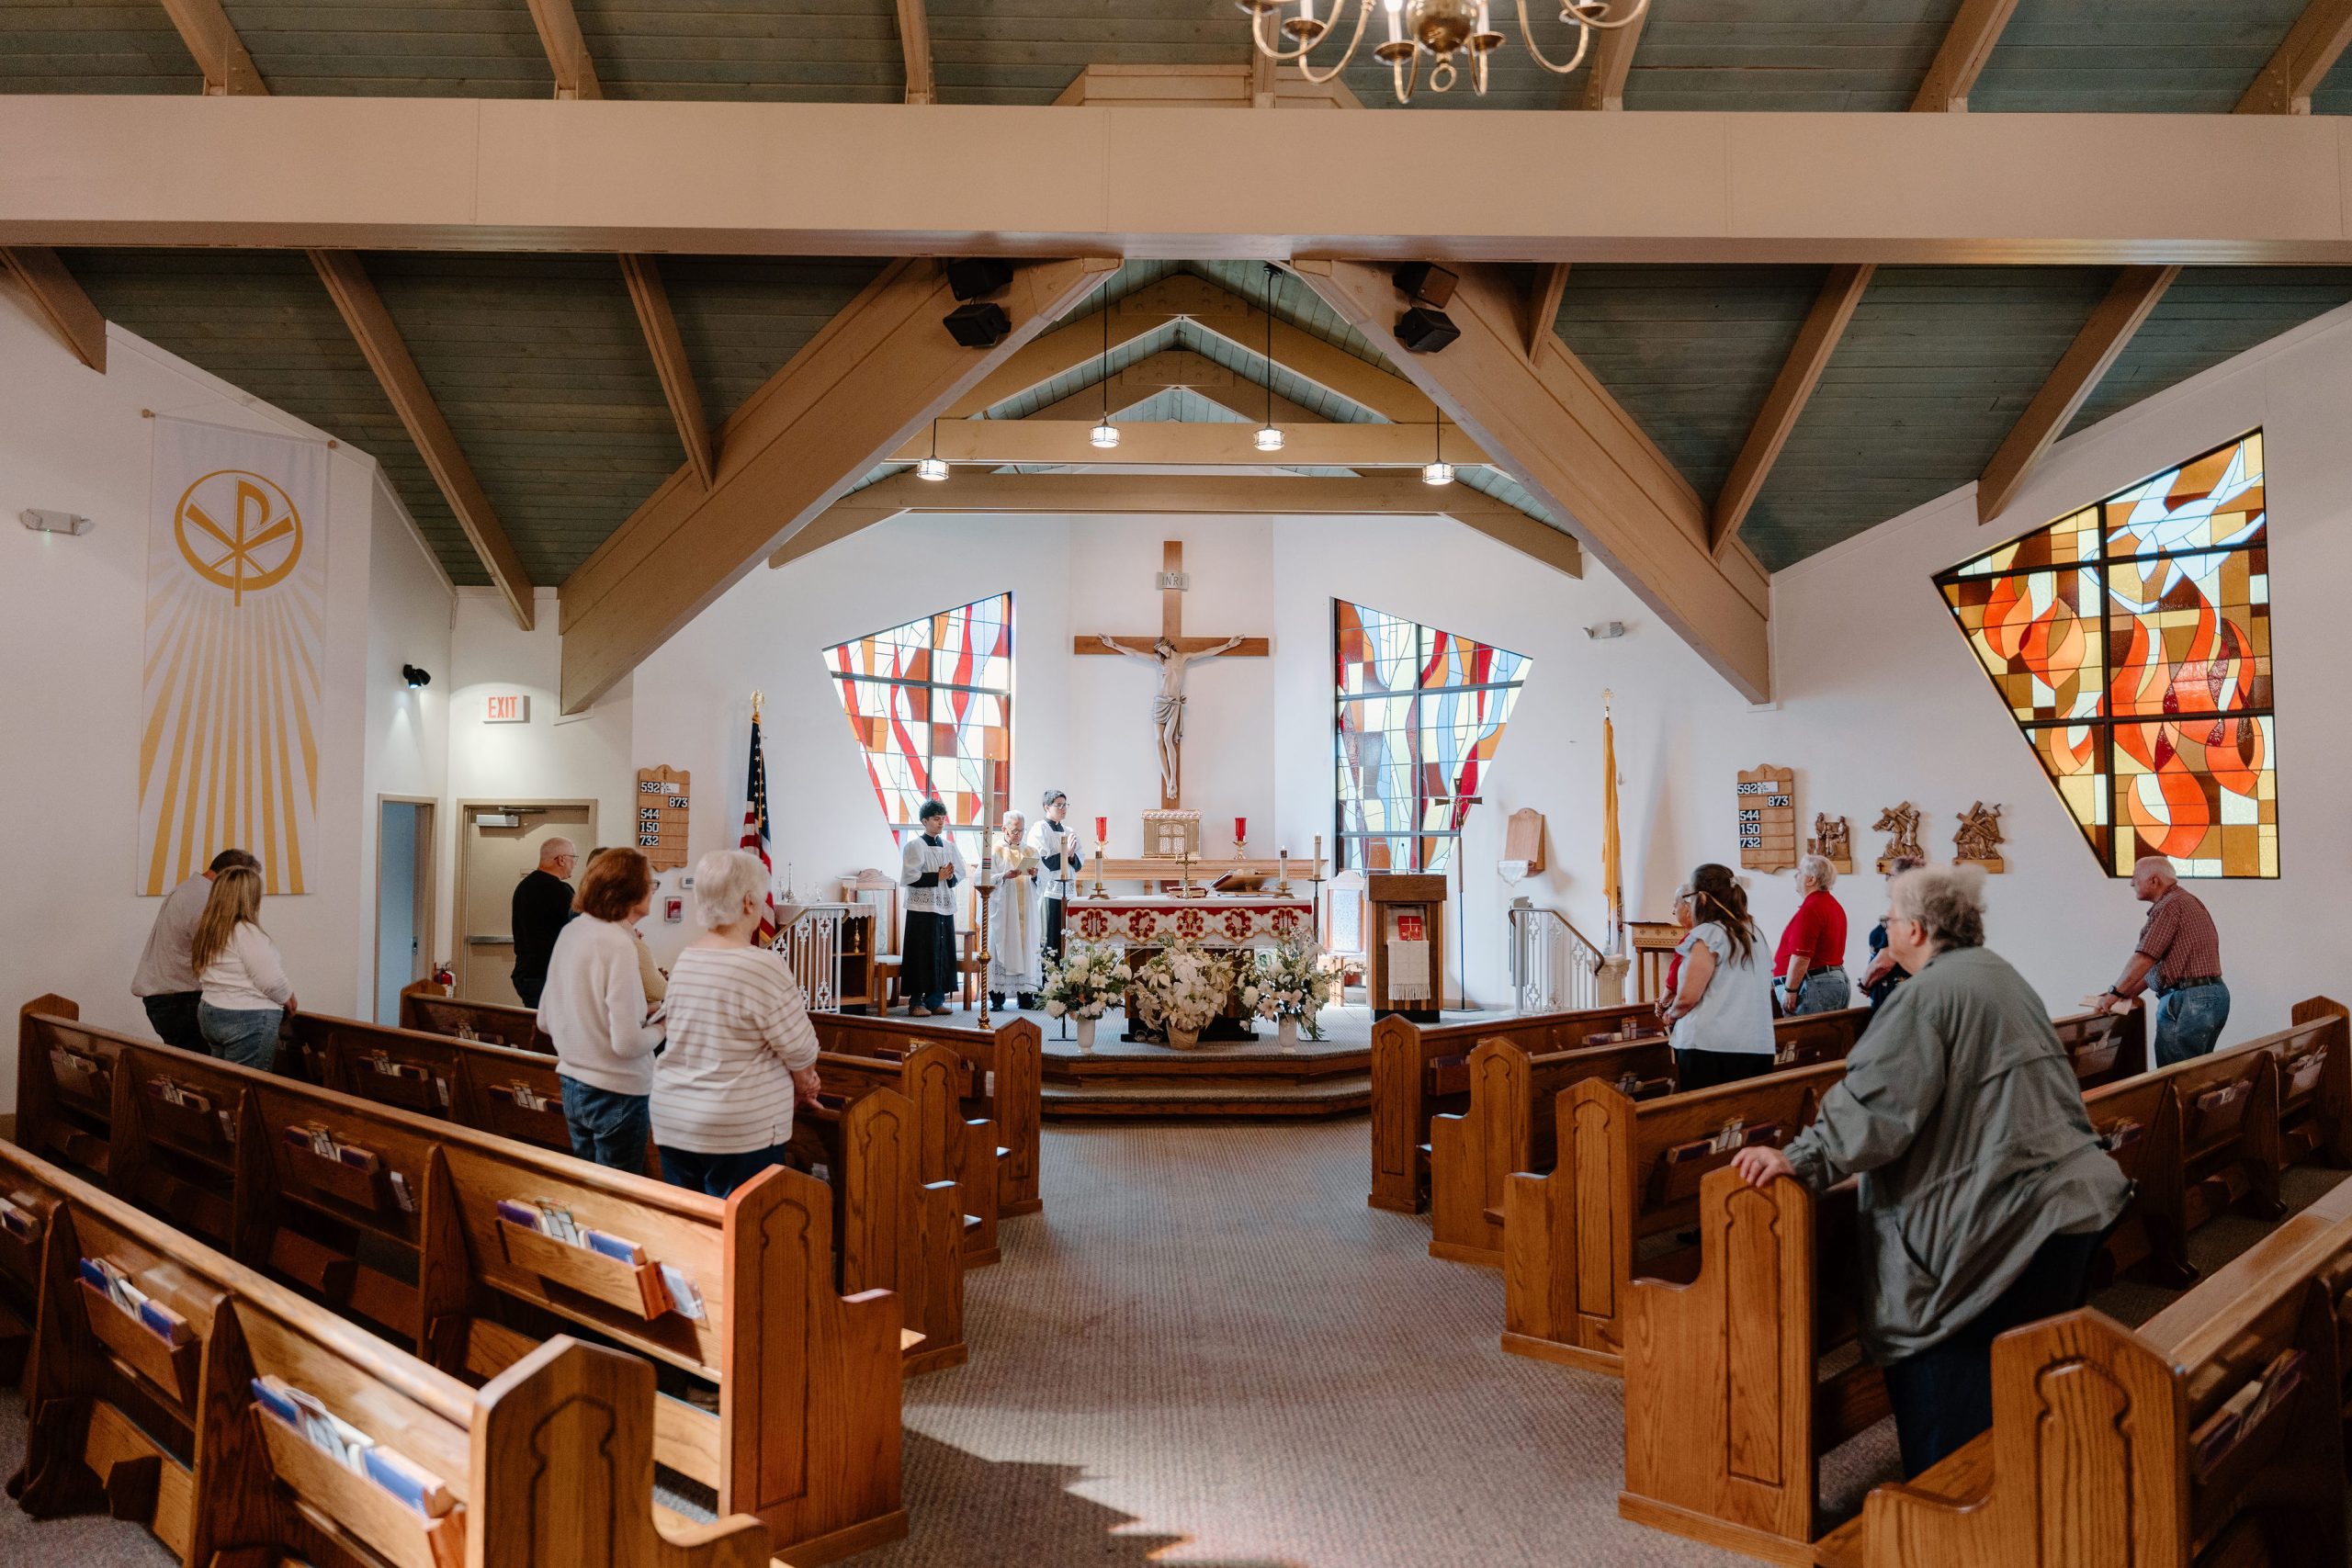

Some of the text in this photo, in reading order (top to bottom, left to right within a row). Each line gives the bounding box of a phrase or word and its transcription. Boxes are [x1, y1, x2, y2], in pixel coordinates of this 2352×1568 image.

[1161, 576, 1183, 586] INRI
[488, 696, 517, 718] EXIT
[640, 782, 661, 793] 592
[1737, 784, 1758, 795] 592
[669, 796, 688, 807] 873
[1768, 795, 1789, 807] 873
[640, 808, 660, 819] 544
[1739, 810, 1759, 821] 544
[640, 821, 660, 832] 150
[1740, 824, 1760, 834] 150
[639, 835, 659, 846] 732
[1740, 837, 1760, 848] 732
